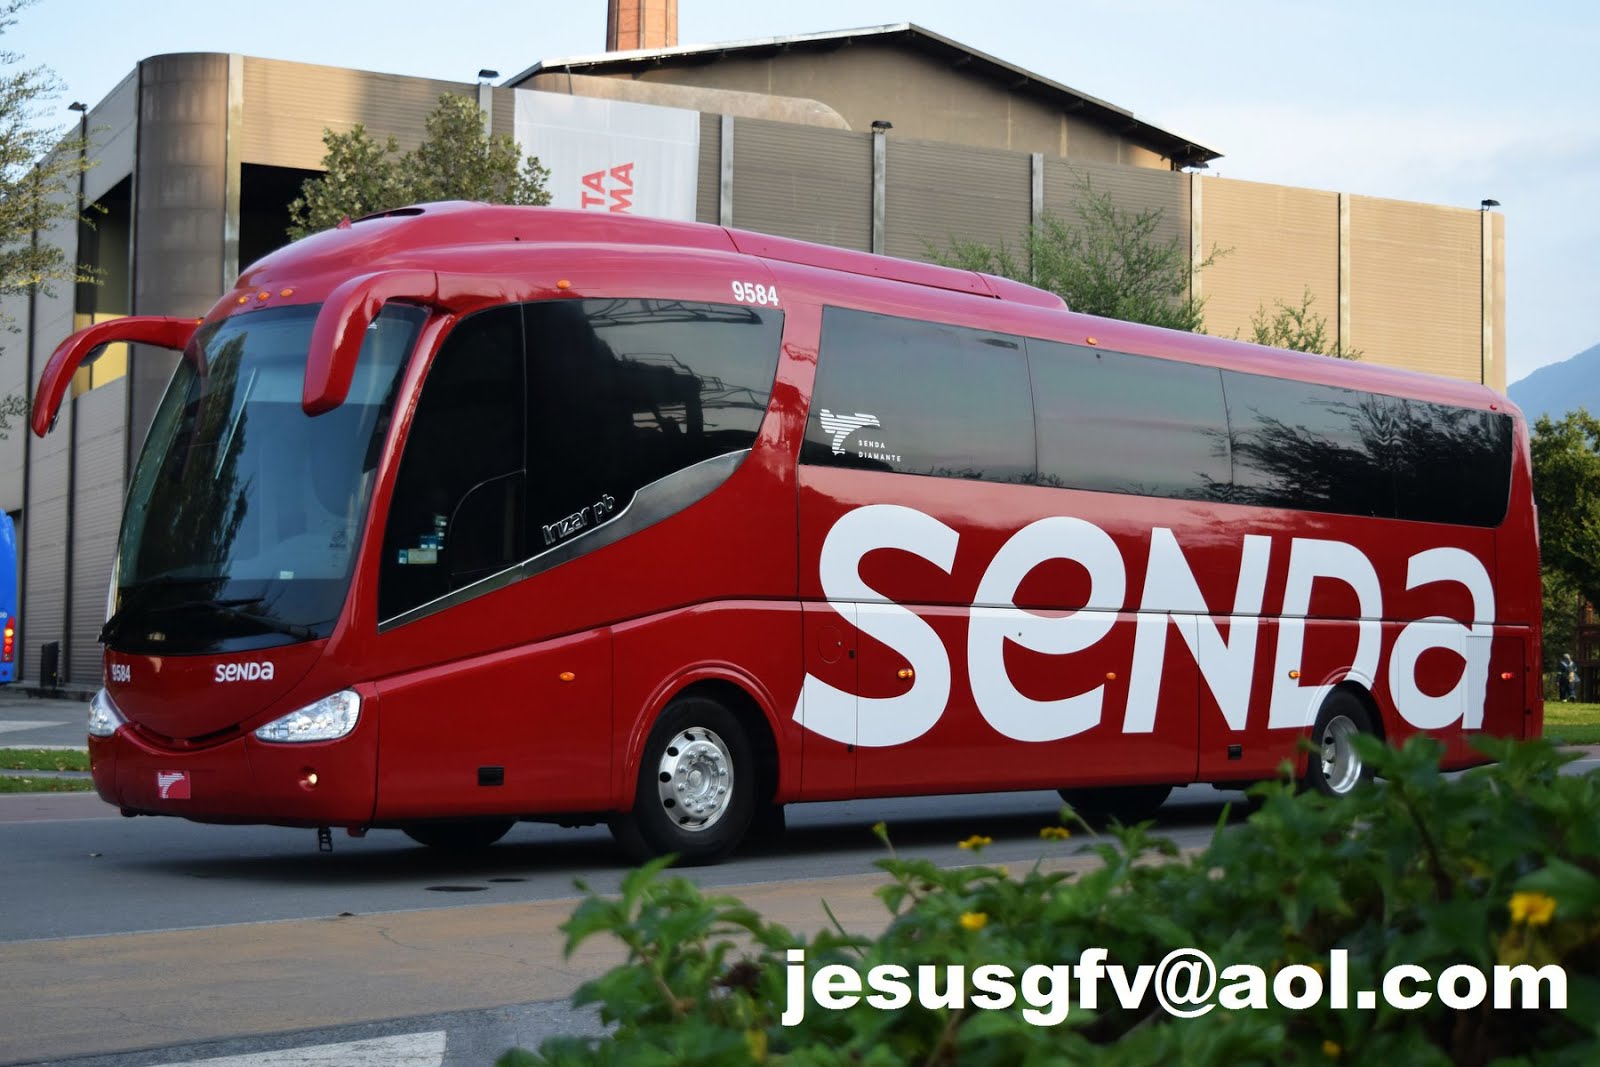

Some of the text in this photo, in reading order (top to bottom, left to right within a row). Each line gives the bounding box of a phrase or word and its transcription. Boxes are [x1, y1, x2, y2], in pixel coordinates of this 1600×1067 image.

[731, 280, 779, 306] 9584
[858, 439, 886, 449] SENDA
[858, 451, 901, 462] DIAMANTE
[111, 664, 131, 682] 9584
